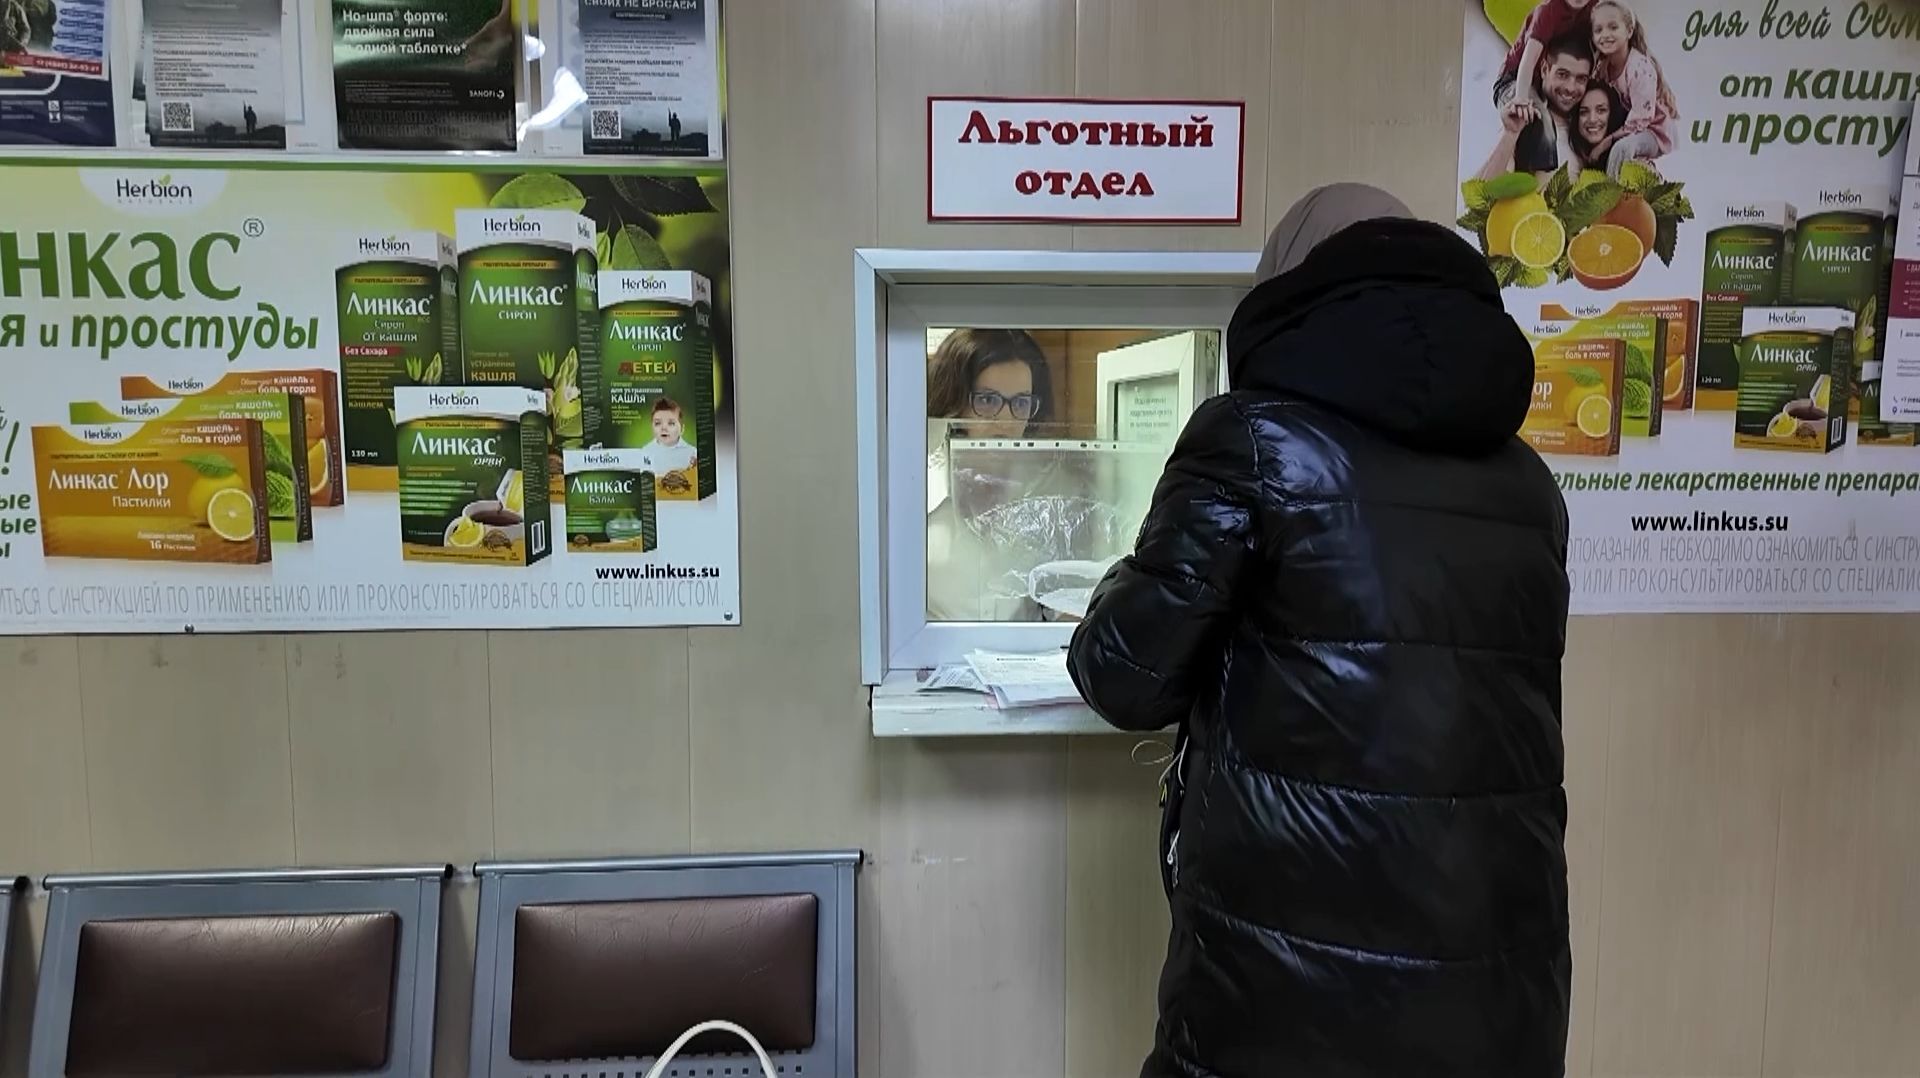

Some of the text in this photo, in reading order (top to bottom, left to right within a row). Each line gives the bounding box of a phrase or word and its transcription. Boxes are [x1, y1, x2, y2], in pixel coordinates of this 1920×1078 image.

[641, 0, 697, 10] БРОСАЕМ
[403, 10, 448, 25] форте:
[1682, 9, 1749, 51] для
[1758, 0, 1832, 40] всей
[343, 25, 435, 39] двойная сила
[355, 41, 396, 55] одной
[1720, 74, 1773, 98] от
[958, 110, 1214, 148] Льготный
[1690, 112, 1909, 158] и просту
[117, 178, 193, 199] Herbion
[1014, 170, 1155, 200] отдел
[1819, 190, 1862, 205] Herbion
[1726, 206, 1765, 218] Herbion
[484, 217, 541, 232] Herbion
[358, 237, 410, 252] Herbion
[1801, 239, 1873, 262] Линкас
[1711, 250, 1775, 270] Линкас
[470, 279, 565, 306] Линкас
[621, 278, 667, 290] Herbion
[346, 291, 430, 316] Линкас
[0, 302, 319, 362] я и простуды
[609, 319, 684, 342] Линкас
[1589, 351, 1611, 360] горле
[1750, 343, 1815, 363] Линкас
[168, 379, 205, 391] Herbion
[471, 371, 516, 382] кашля
[289, 385, 317, 395] горле
[429, 393, 479, 406] Herbion
[121, 405, 160, 418] Herbion
[251, 410, 283, 421] горле
[84, 429, 122, 441] Herbion
[197, 424, 233, 434] кашель
[180, 434, 203, 444] боль
[213, 434, 242, 446] горле
[411, 431, 497, 456] Линкас
[48, 466, 170, 498] Линкас Лор
[570, 477, 633, 494] Линкас
[1635, 471, 1822, 497] лекарственные
[1824, 471, 1920, 498] препара
[112, 494, 172, 509] Пастилки
[1631, 510, 1788, 532] www.linkus.su
[149, 538, 162, 550] 16
[1659, 536, 1752, 566] НЕОБХОДИМО
[1756, 535, 1859, 564] ОЗНАКОМИТЬСЯ
[595, 563, 720, 580] www.linkus.su
[1583, 568, 1613, 594] ИЛИ
[1618, 566, 1807, 595] ПРОКОНСУЛЬТИРОВАТЬСЯ
[1812, 567, 1833, 593] СО
[60, 581, 162, 617] ИНСТРУКЦИЕЙ
[166, 586, 190, 615] ПО
[195, 585, 312, 615] ПРИМЕНЕНИЮ
[317, 585, 350, 614] ИЛИ
[355, 581, 559, 613] ПРОКОНСУЛЬТИРОВАТЬСЯ
[565, 582, 586, 609] СО
